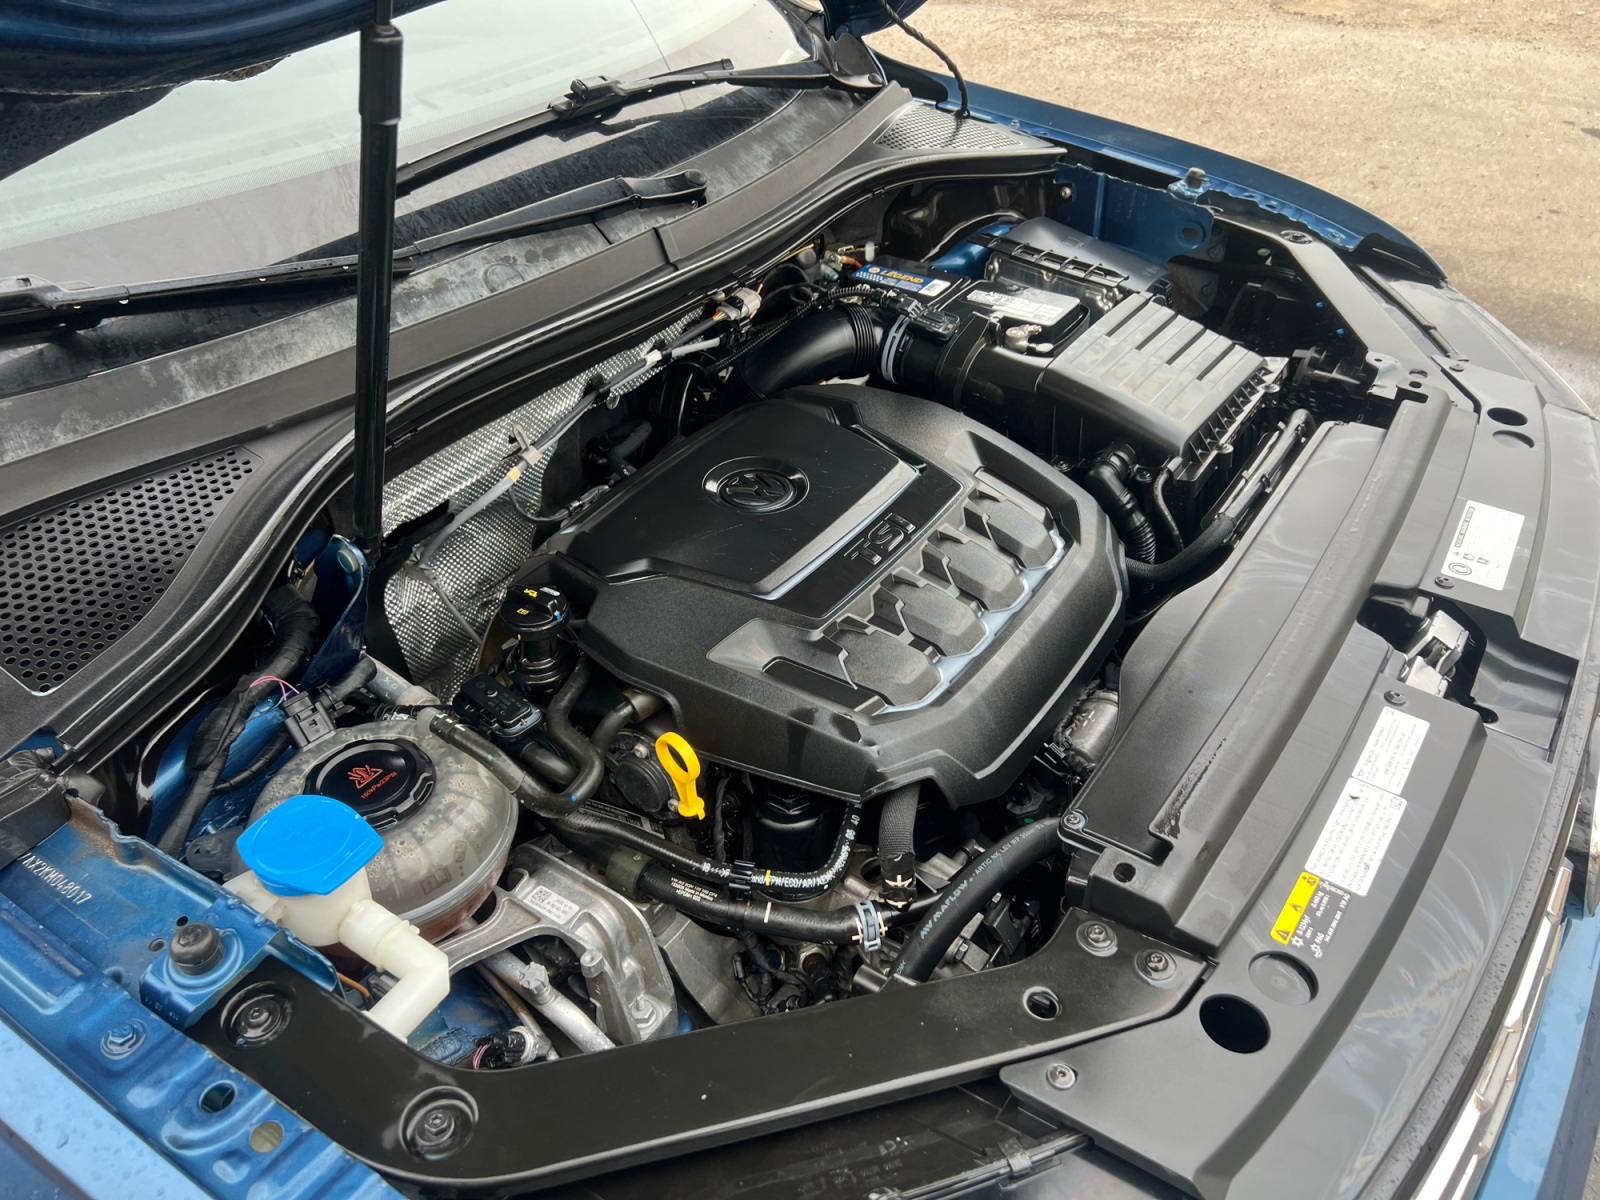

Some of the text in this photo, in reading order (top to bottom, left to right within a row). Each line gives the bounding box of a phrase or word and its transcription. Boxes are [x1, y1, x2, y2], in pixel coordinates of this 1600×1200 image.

[881, 269, 925, 284] LEGEND
[843, 512, 917, 566] TSI
[933, 879, 969, 923] MAFLOW
[974, 857, 993, 876] ARTIC
[1000, 842, 1012, 854] LEV
[1314, 931, 1325, 944] PAG
